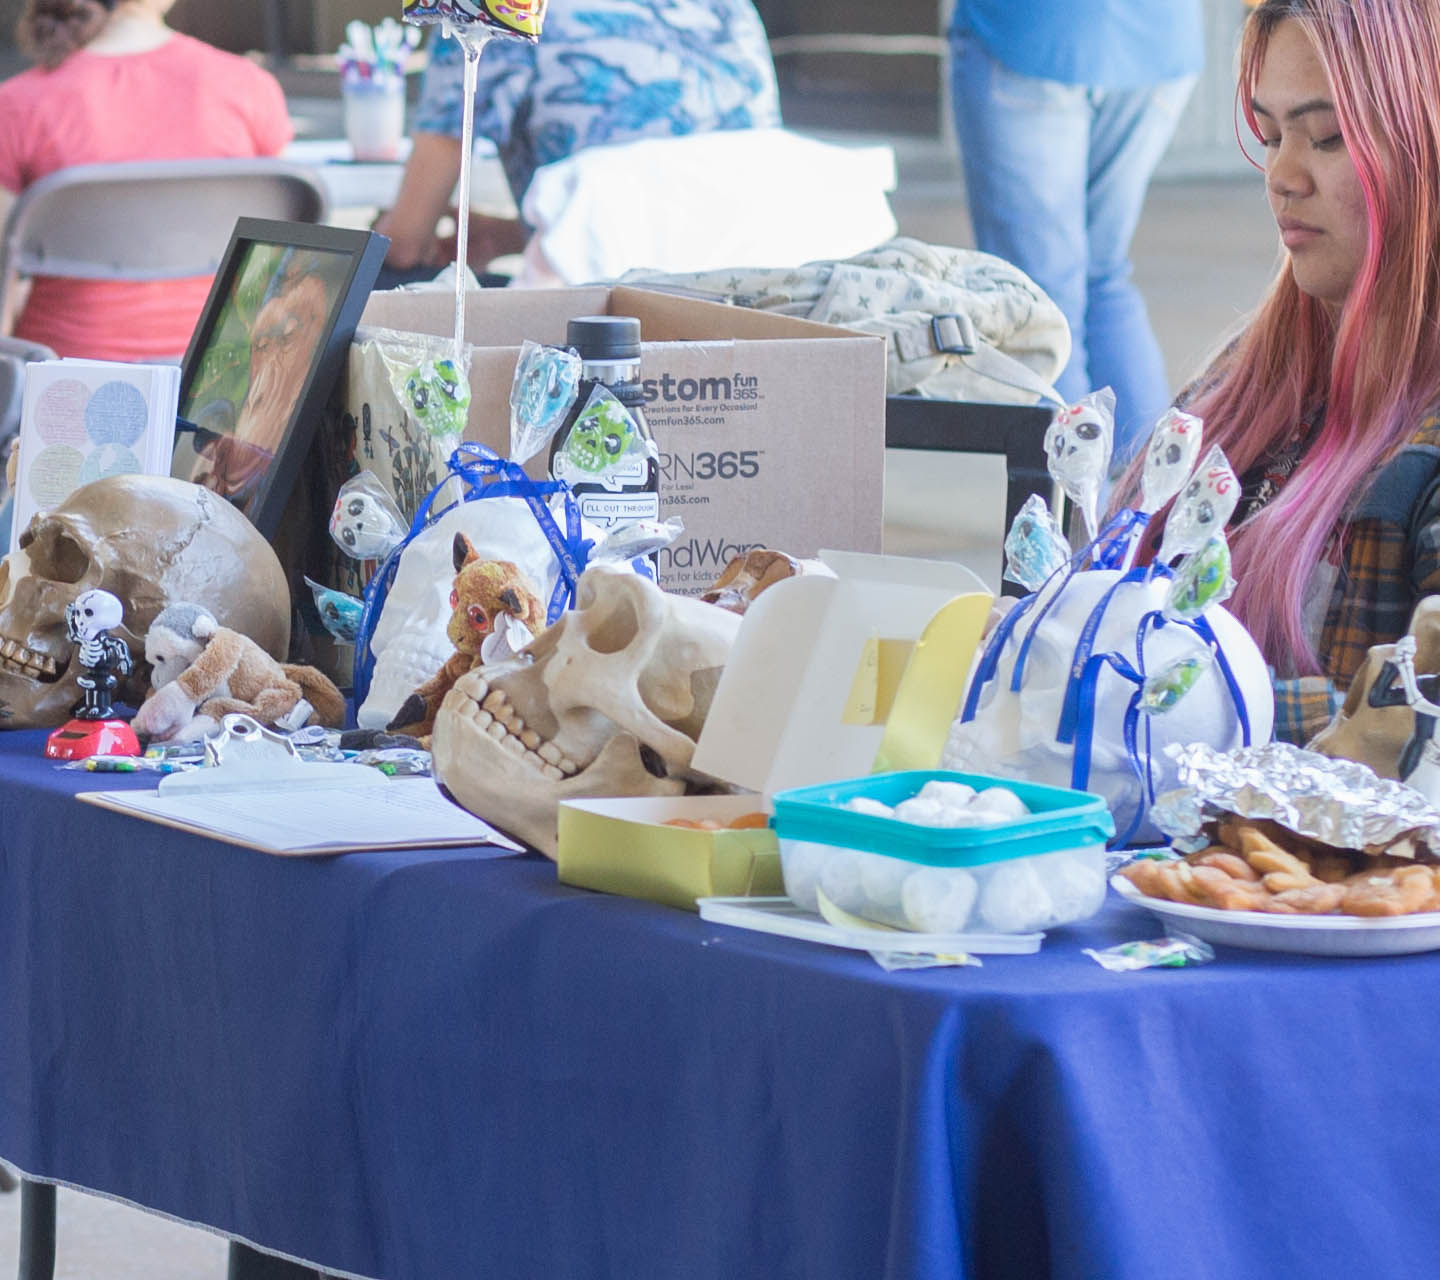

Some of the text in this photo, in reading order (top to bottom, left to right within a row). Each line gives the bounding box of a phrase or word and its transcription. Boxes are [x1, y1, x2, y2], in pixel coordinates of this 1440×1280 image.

[732, 372, 758, 387] fun
[732, 388, 759, 400] 365
[695, 404, 718, 413] Every
[677, 572, 691, 582] for
[693, 571, 713, 581] kids
